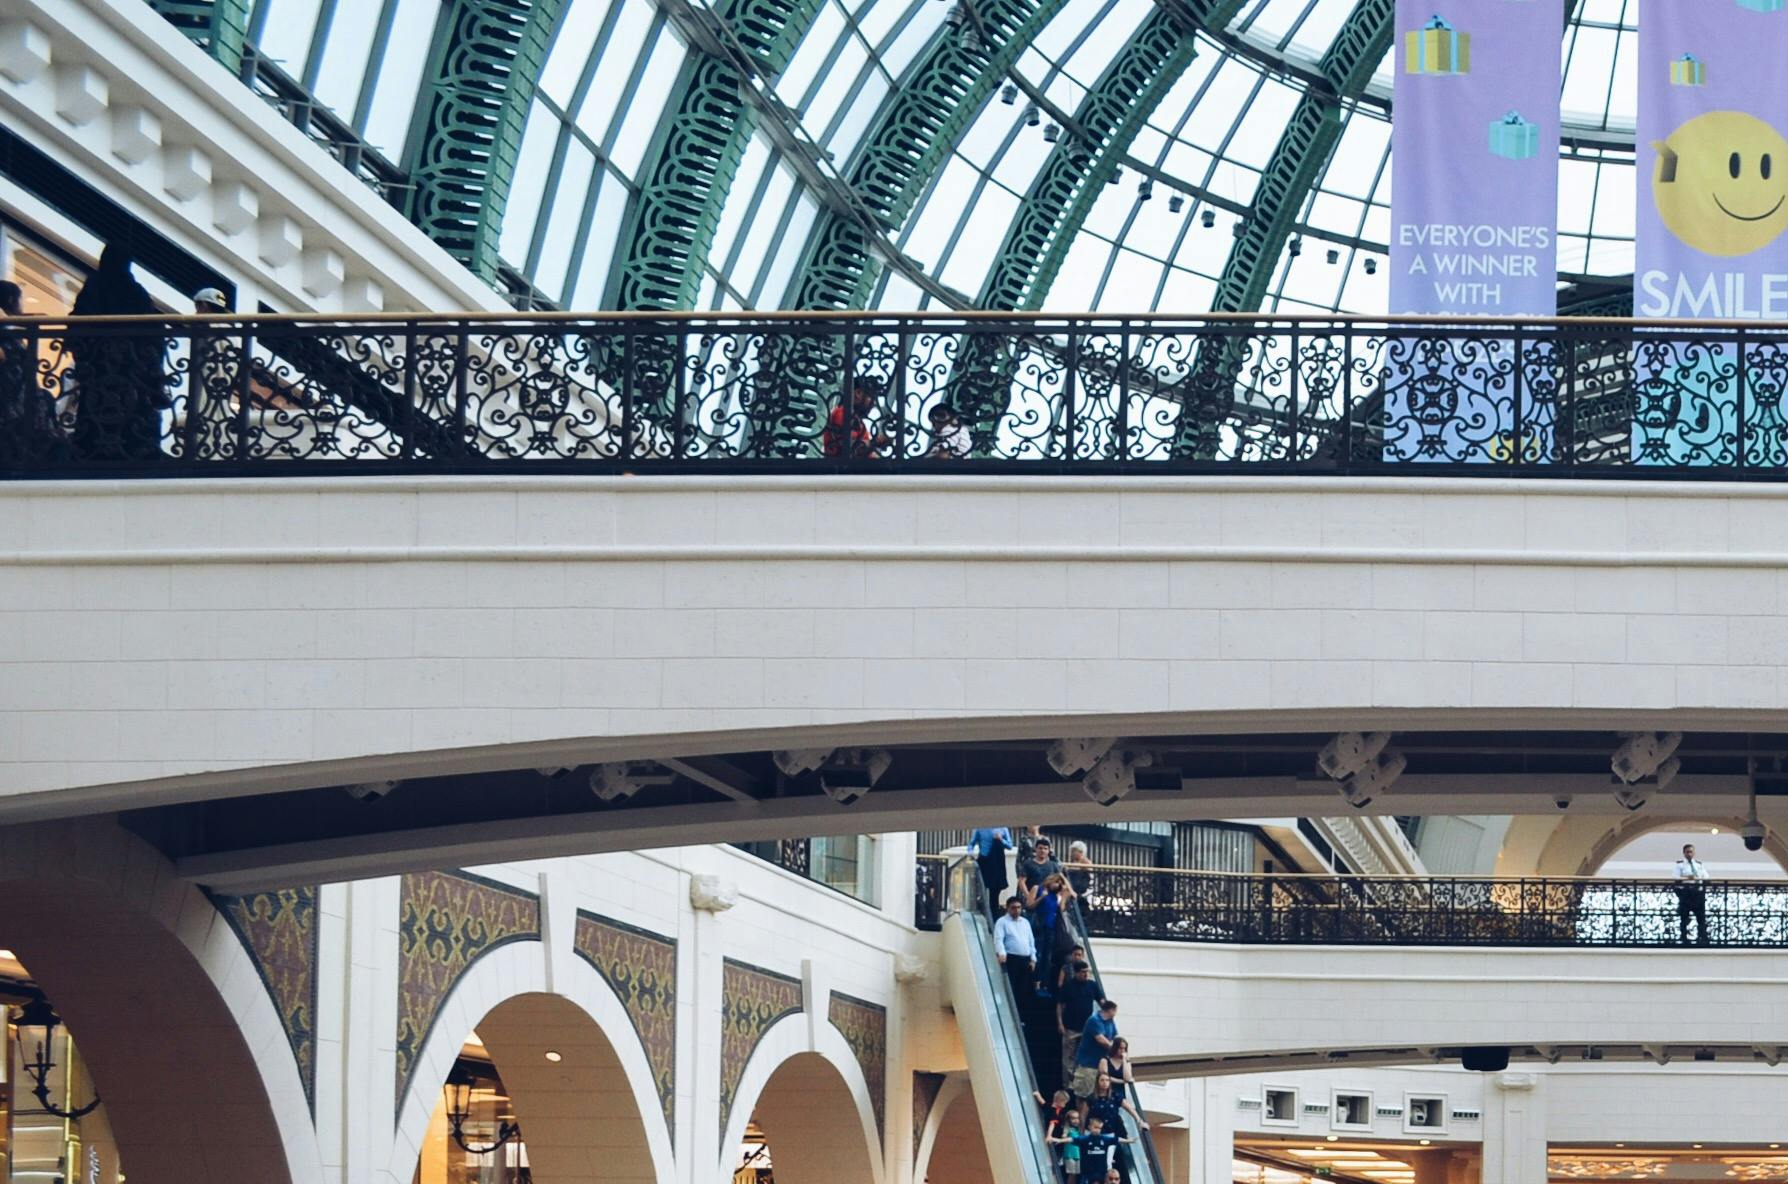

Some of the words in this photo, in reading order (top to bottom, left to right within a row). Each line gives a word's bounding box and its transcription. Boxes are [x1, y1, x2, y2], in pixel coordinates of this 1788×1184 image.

[1400, 224, 1549, 249] EVERYONE'S
[1408, 253, 1428, 275] A
[1433, 253, 1538, 277] WINNER
[1434, 282, 1500, 305] WITH
